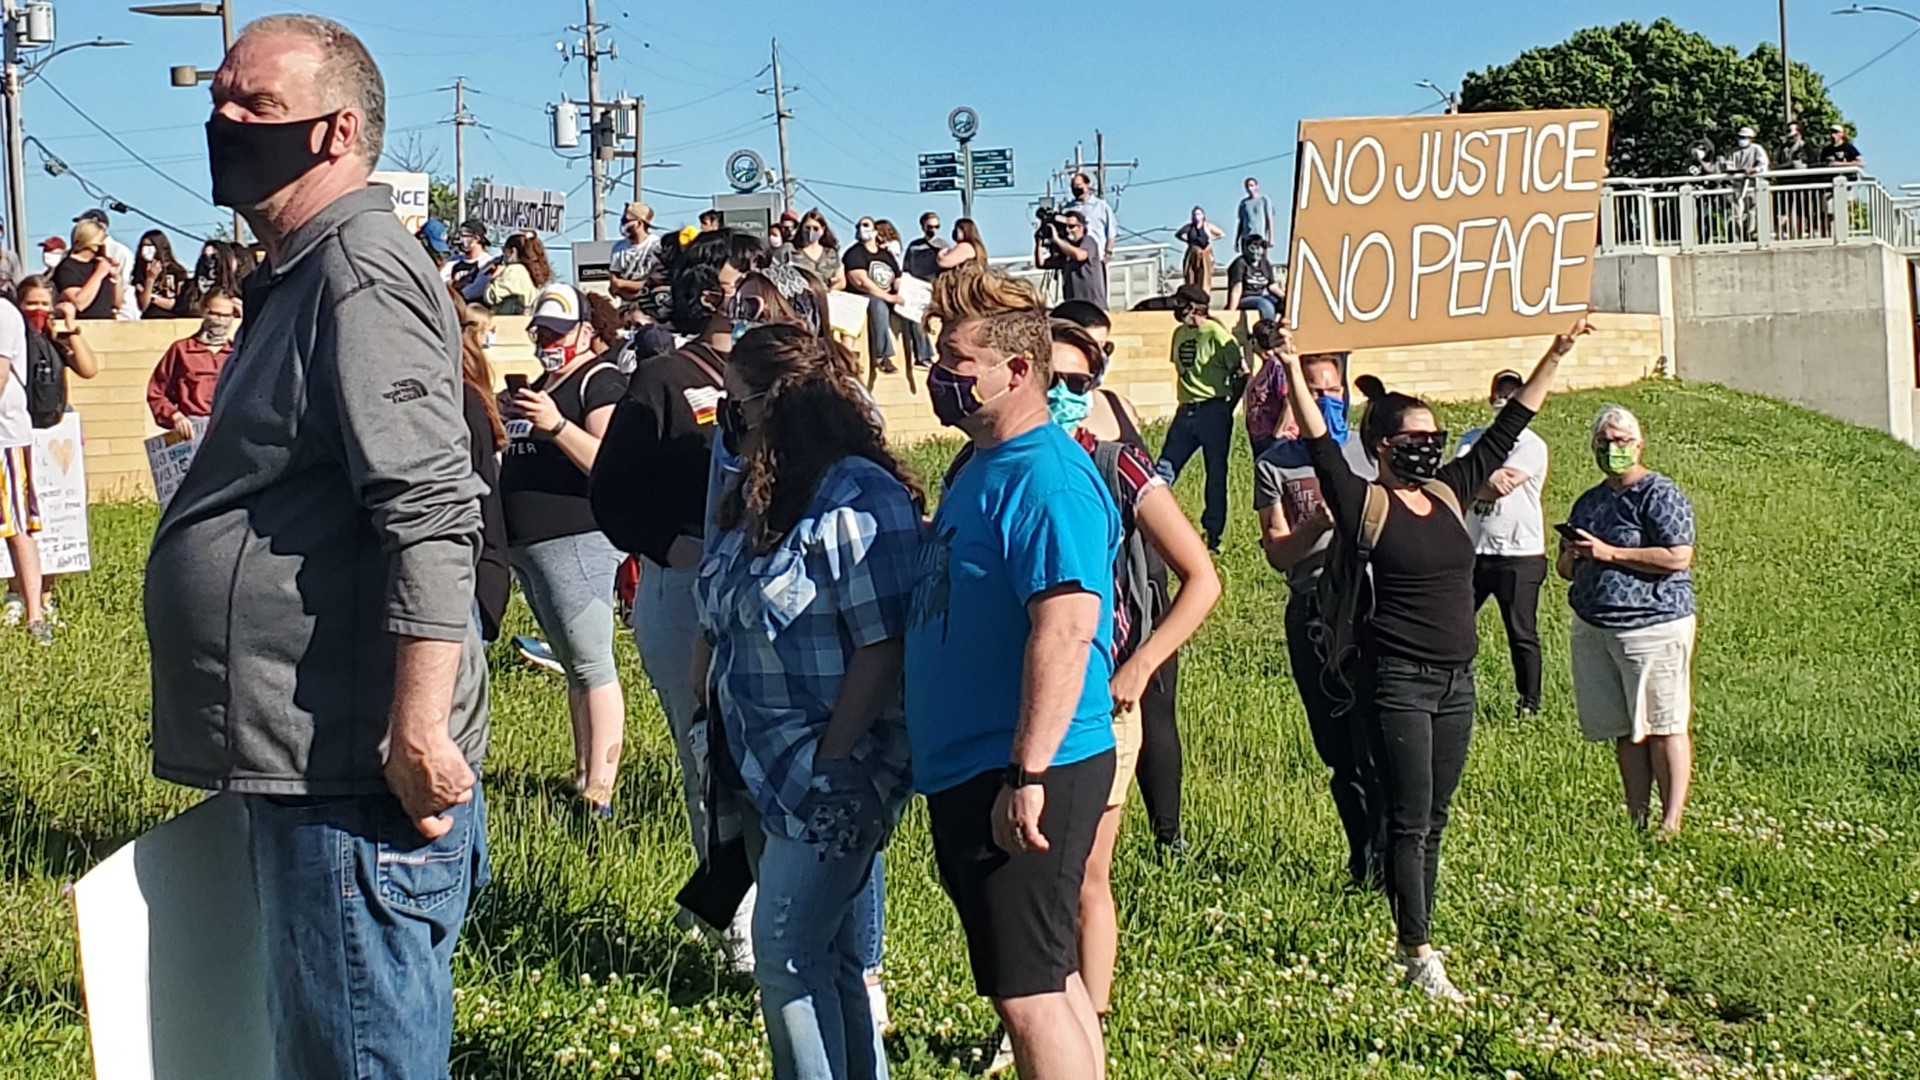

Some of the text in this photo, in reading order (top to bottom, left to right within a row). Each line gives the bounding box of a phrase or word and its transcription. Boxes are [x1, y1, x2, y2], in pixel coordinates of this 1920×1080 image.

[1301, 121, 1599, 209] NO JUSTICE
[1291, 212, 1594, 330] NO PEACE
